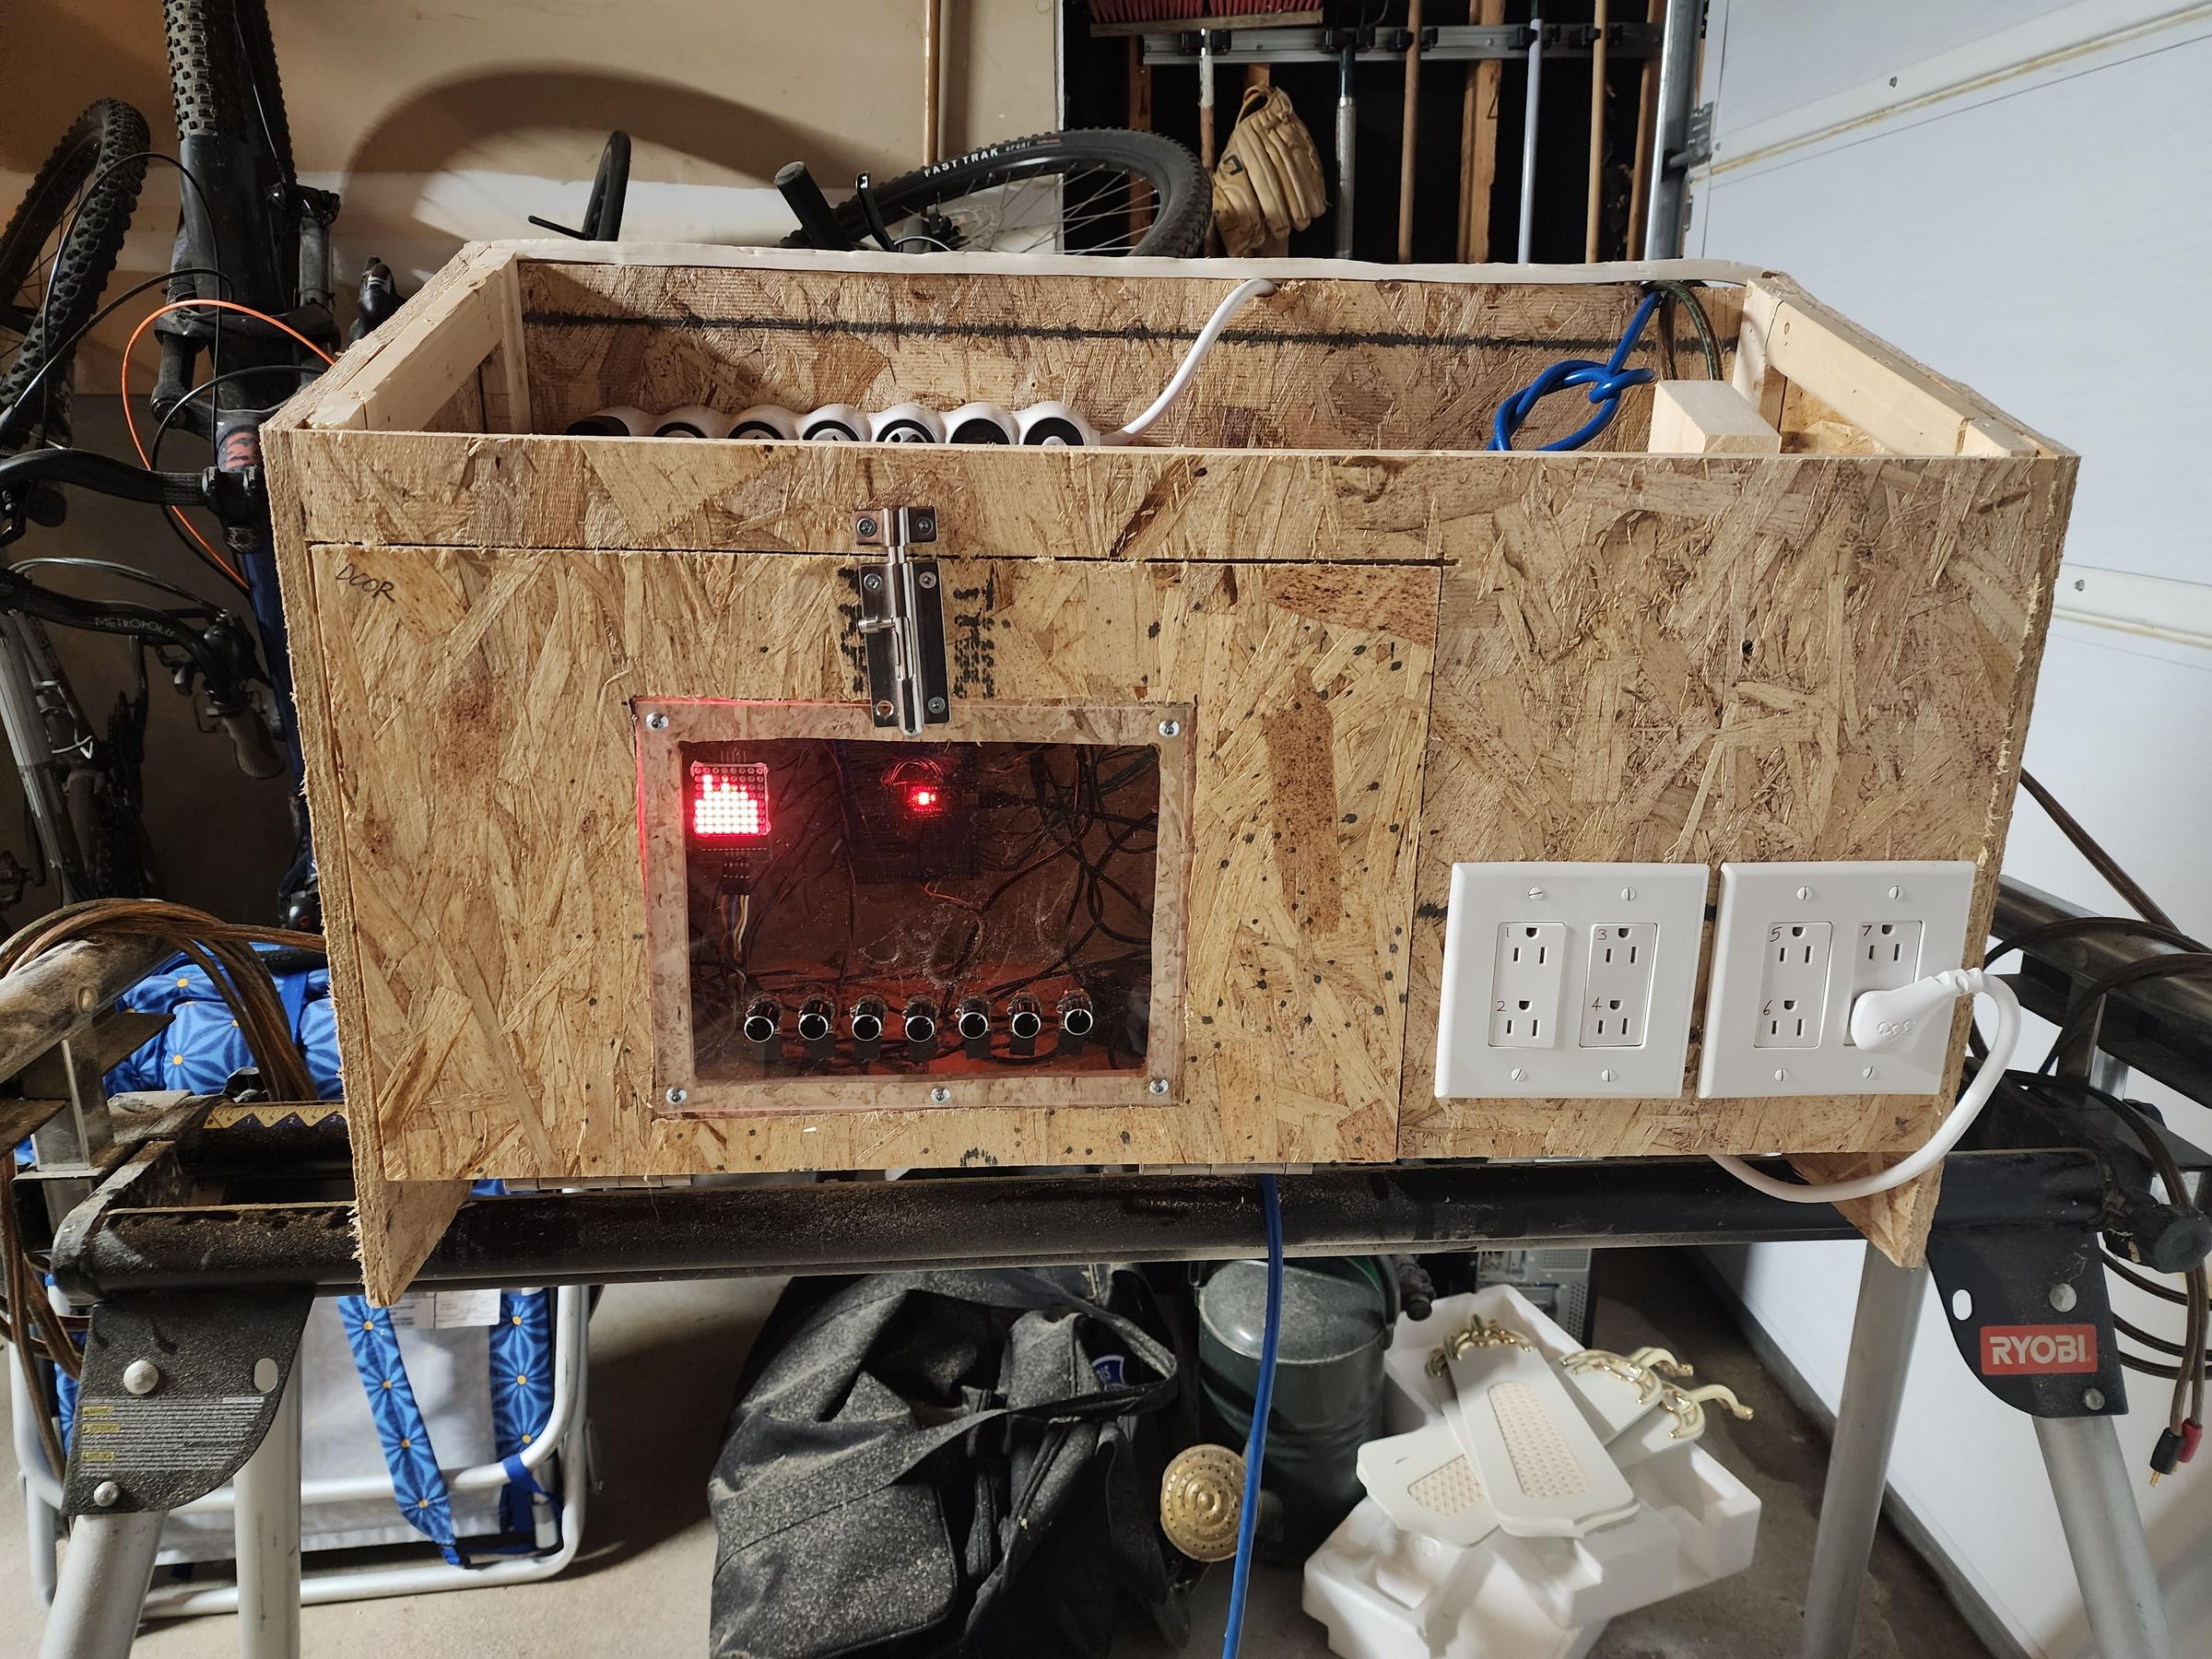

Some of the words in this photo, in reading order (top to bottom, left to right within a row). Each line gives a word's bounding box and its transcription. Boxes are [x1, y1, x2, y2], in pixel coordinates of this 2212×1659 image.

[924, 159, 958, 178] FAST
[961, 147, 999, 165] TRAK
[335, 563, 395, 604] DOOR
[95, 617, 177, 637] METROPOLIS
[1597, 928, 1607, 941] 3
[1769, 926, 1783, 942] 5
[1862, 924, 1873, 937] 7
[1496, 1001, 1507, 1012] 2
[1591, 997, 1603, 1011] 4
[1762, 999, 1772, 1016] 6
[1989, 1334, 2087, 1365] RYOBI
